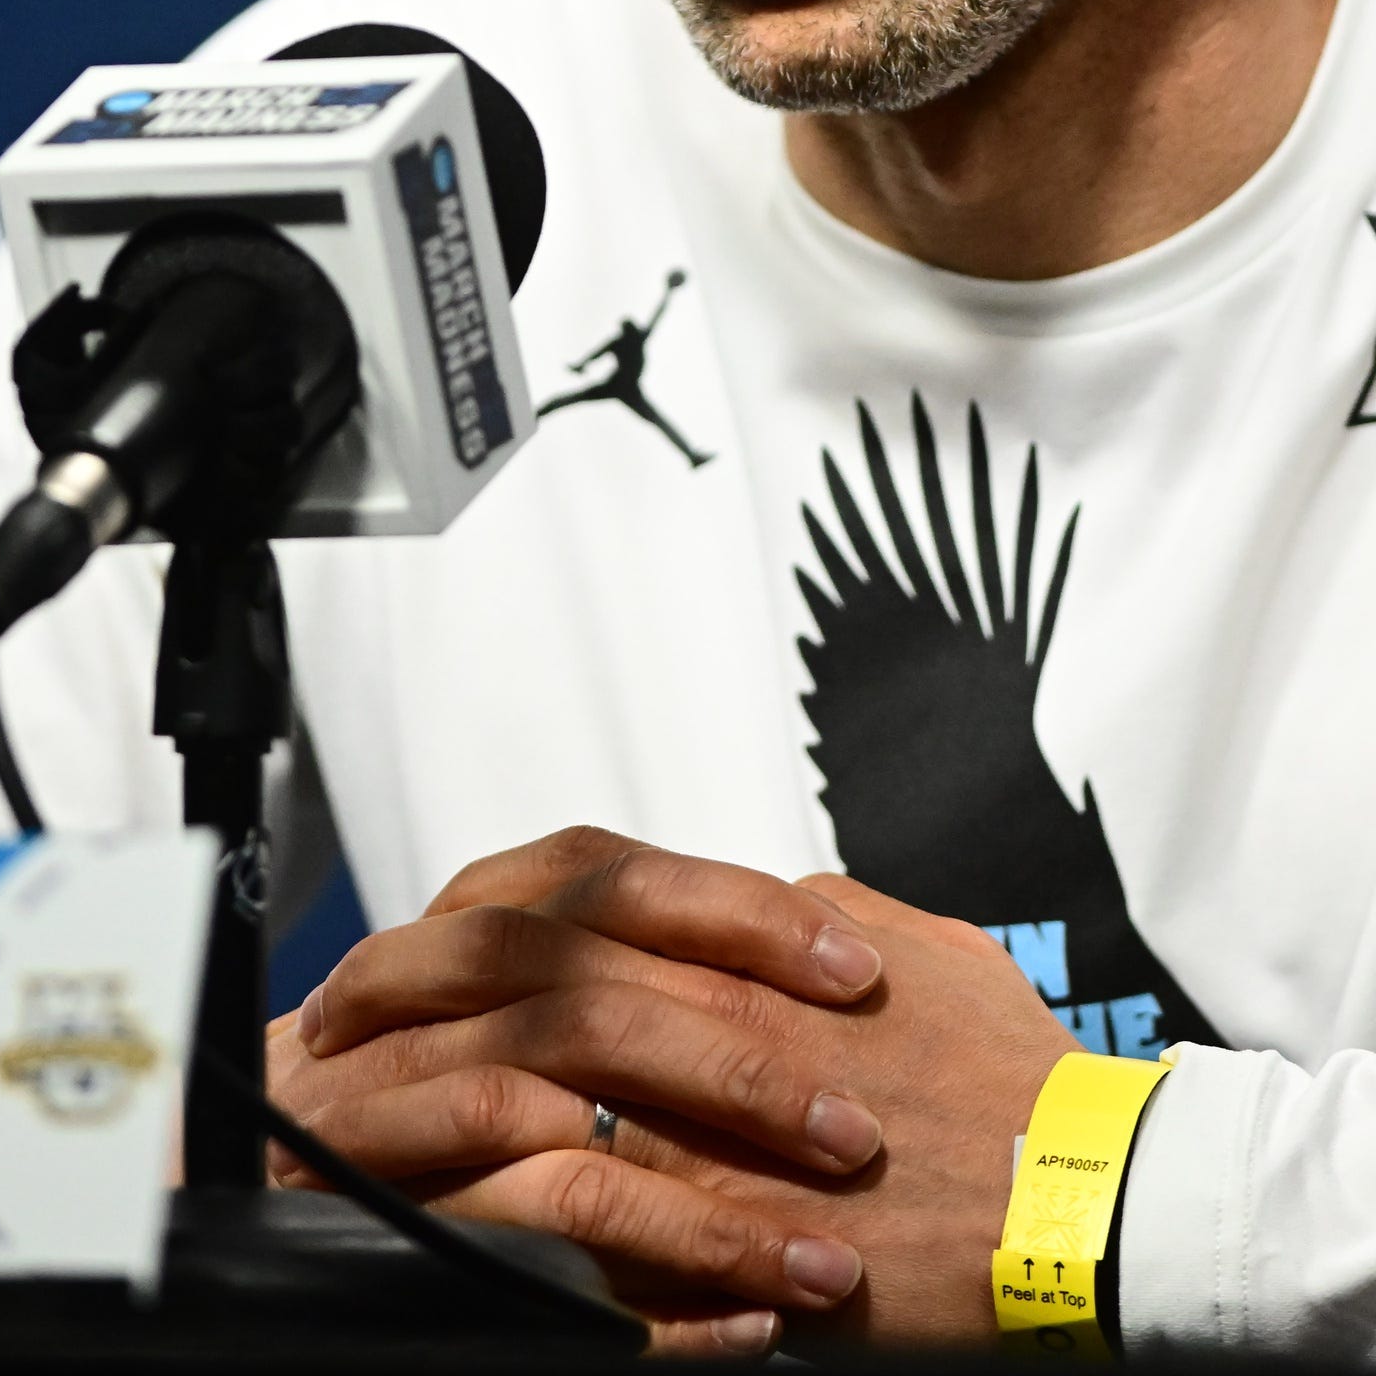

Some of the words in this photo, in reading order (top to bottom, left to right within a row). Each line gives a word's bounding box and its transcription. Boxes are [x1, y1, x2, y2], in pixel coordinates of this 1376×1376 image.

[436, 194, 489, 363] MARCH
[422, 234, 486, 461] MADNESS
[1036, 1153, 1110, 1173] AP190057
[1001, 1284, 1037, 1302] Peel
[1040, 1290, 1057, 1305] at
[1059, 1290, 1087, 1310] Top
